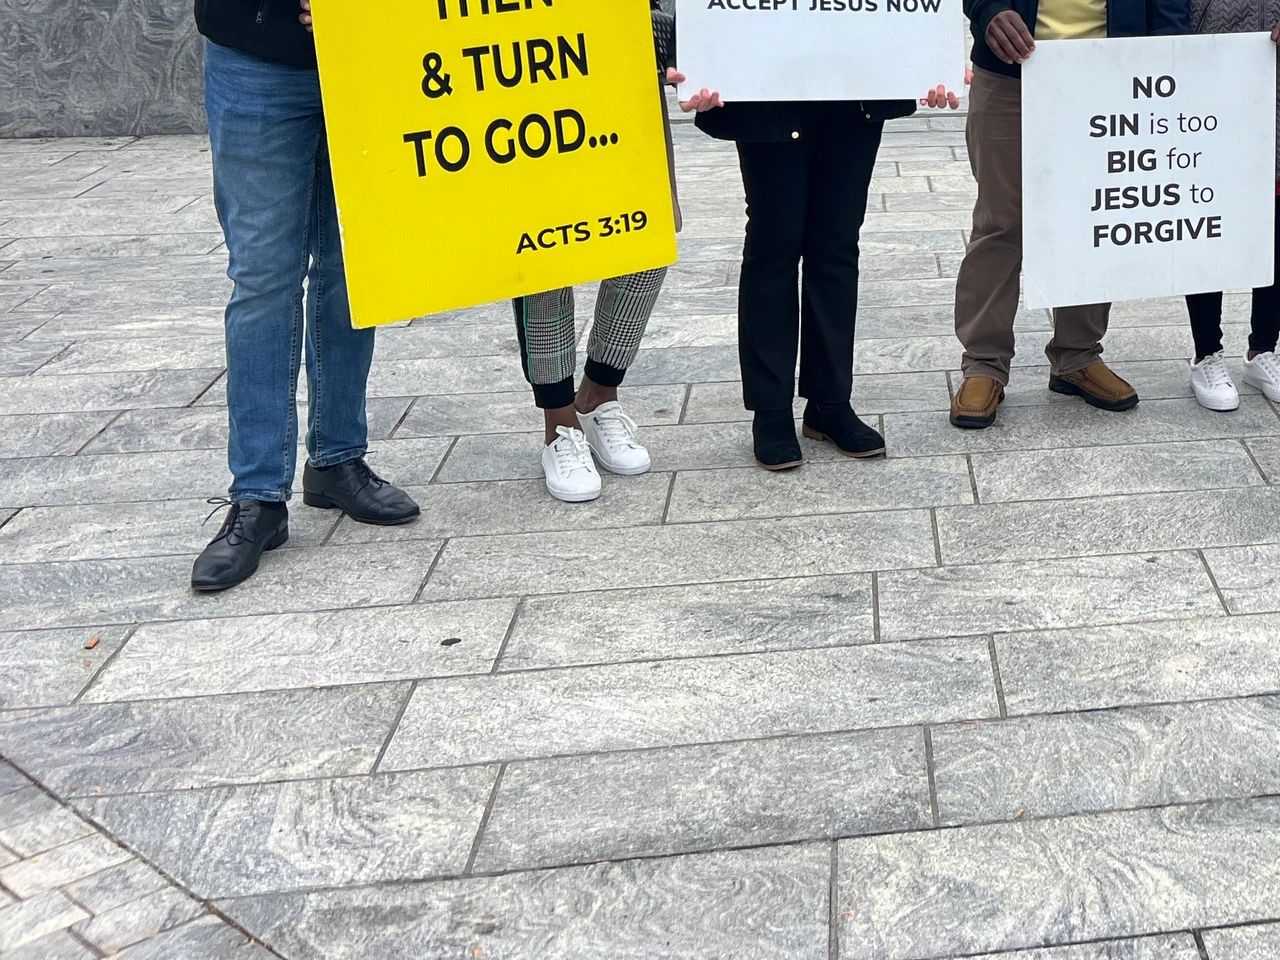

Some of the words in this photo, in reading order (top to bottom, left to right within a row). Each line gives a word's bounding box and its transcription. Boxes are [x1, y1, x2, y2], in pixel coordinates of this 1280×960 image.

[422, 52, 453, 99] &
[462, 33, 589, 92] TURN
[1132, 75, 1176, 99] NO
[1089, 113, 1139, 138] SIN
[1150, 113, 1169, 135] is
[1177, 112, 1218, 133] too
[403, 126, 470, 177] TO
[485, 109, 619, 164] GOD...
[1107, 148, 1157, 174] BIG
[1166, 147, 1202, 170] for
[1091, 183, 1181, 212] JESUS
[1189, 183, 1214, 204] to
[516, 222, 591, 255] ACTS
[599, 210, 648, 237] 3:19
[1093, 215, 1222, 248] FORGIVE
